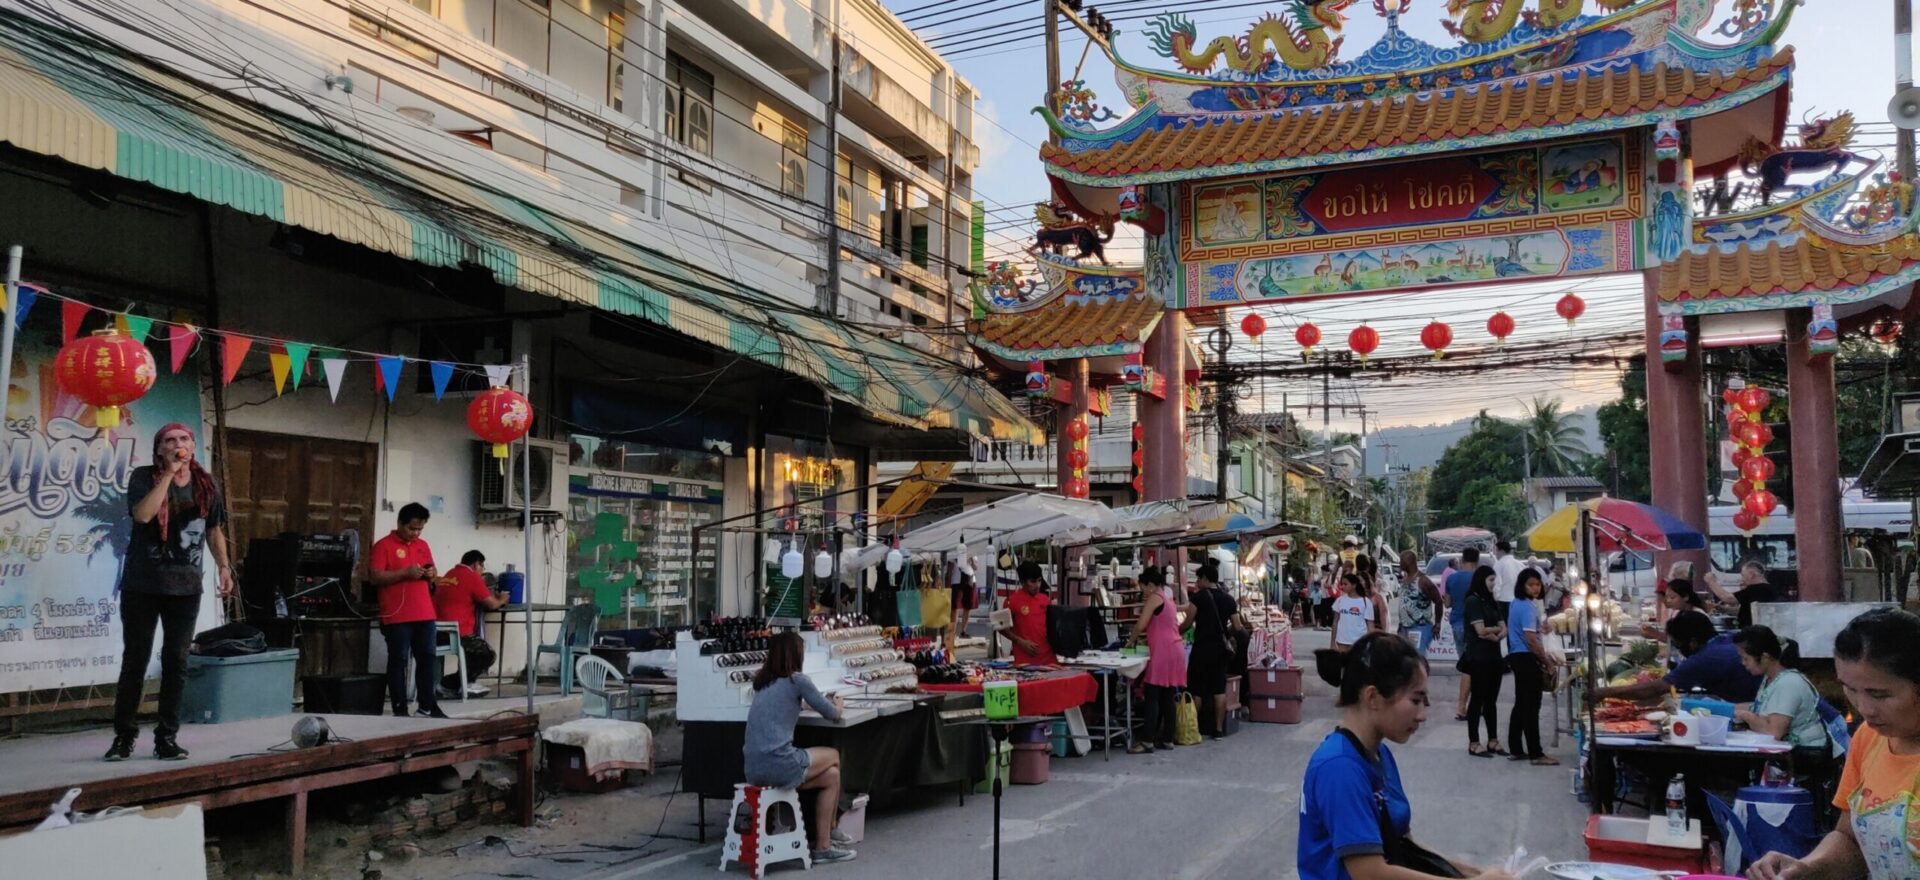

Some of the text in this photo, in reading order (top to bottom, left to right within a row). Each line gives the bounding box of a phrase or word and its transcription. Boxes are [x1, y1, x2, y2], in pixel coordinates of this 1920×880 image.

[1323, 174, 1475, 218] ขอให้ โชคดี
[592, 474, 615, 491] MEDICINE
[620, 478, 648, 494] SUPPLEMENT
[675, 484, 691, 497] DRUG
